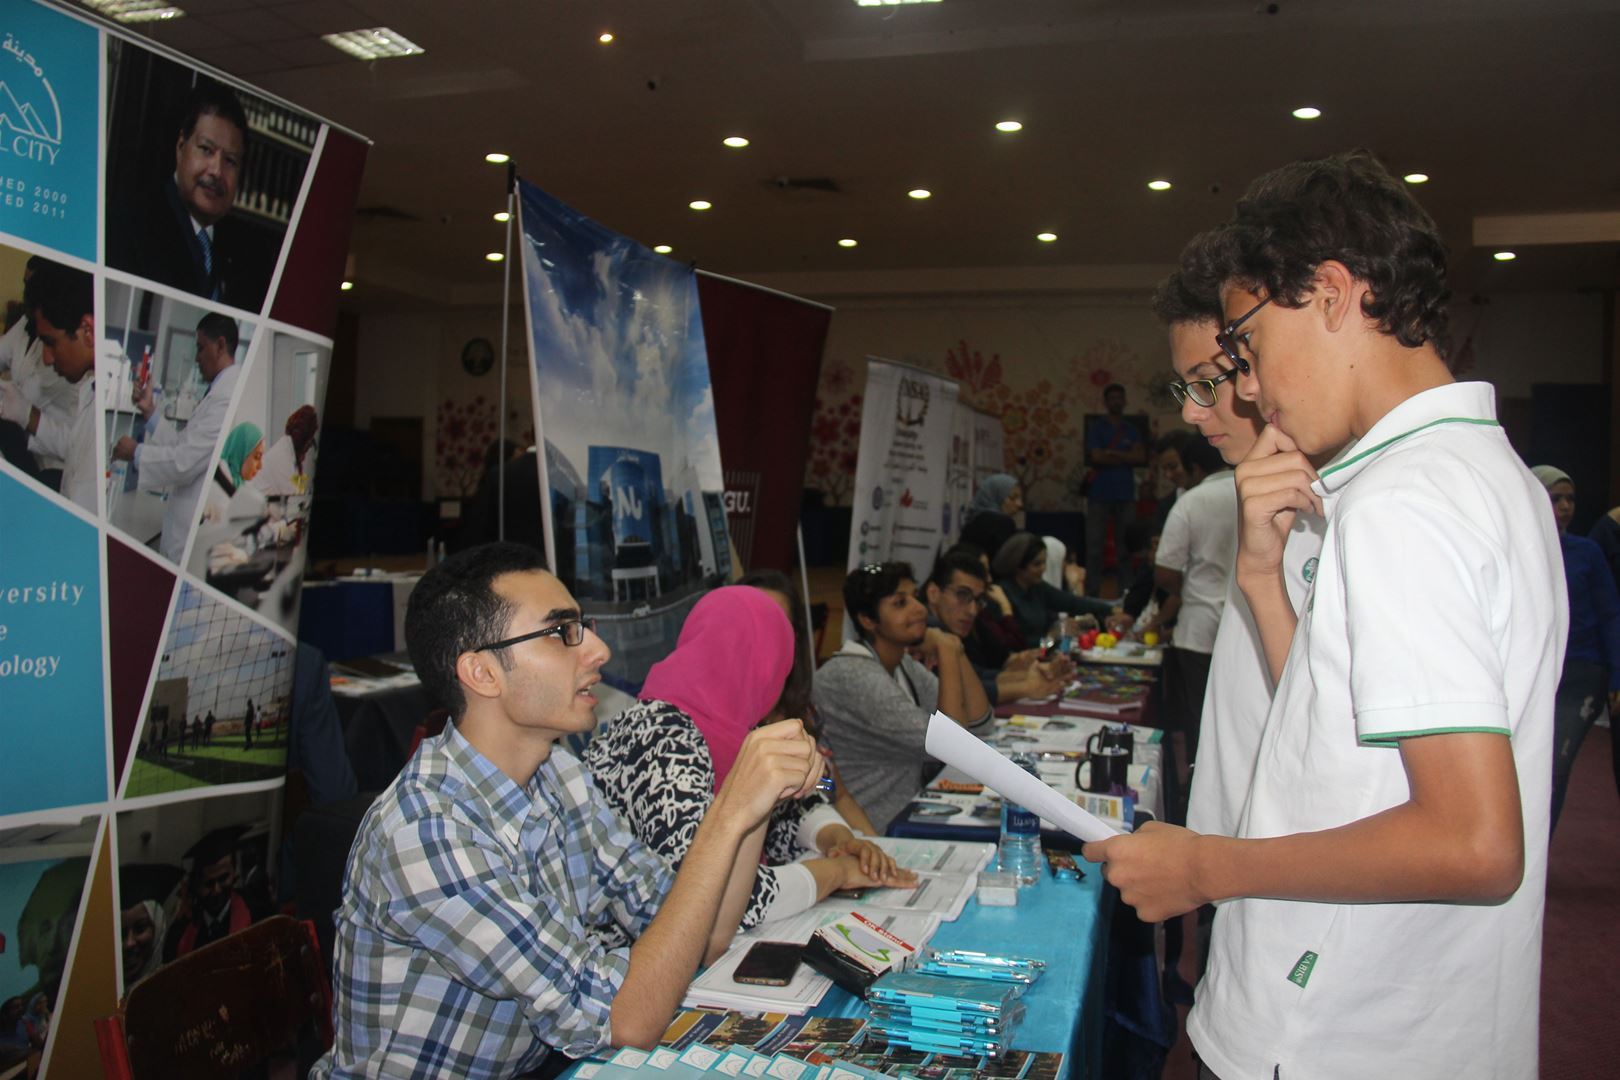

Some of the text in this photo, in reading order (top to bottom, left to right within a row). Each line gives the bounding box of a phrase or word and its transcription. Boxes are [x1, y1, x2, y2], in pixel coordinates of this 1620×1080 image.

[12, 135, 60, 165] CITY
[0, 191, 65, 219] ED 2011
[34, 185, 67, 204] 2000
